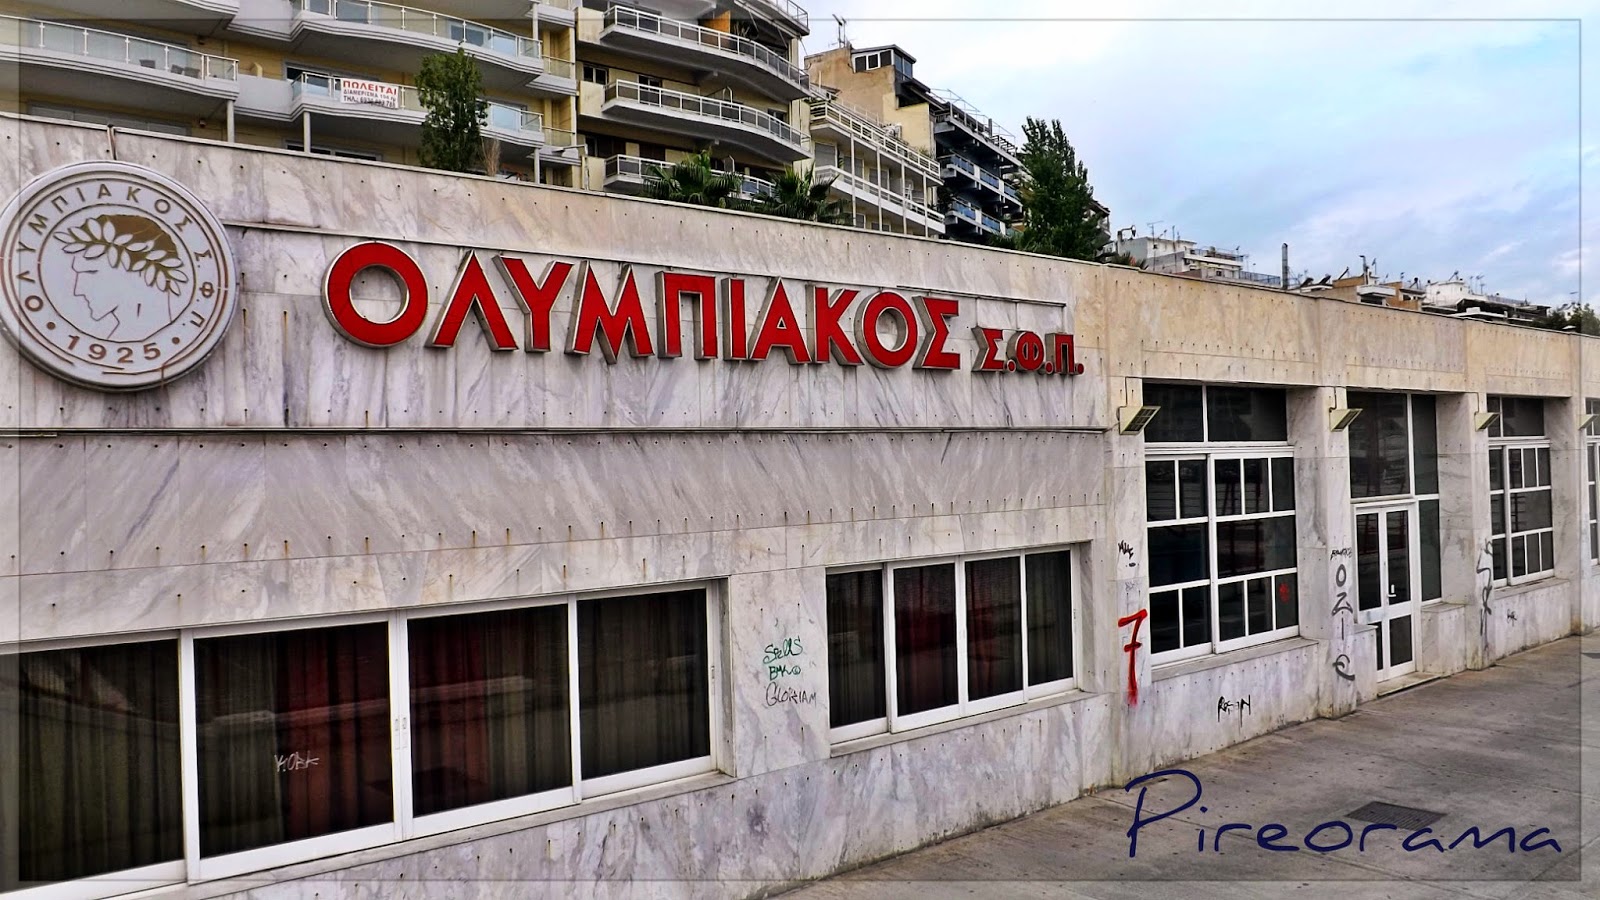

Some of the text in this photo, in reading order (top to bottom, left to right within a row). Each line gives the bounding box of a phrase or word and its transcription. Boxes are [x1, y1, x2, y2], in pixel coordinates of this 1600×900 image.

[343, 80, 397, 95] ΠΩΛΕΙΤΑΙ
[343, 89, 378, 98] ΔΙΑΜΕΡΙΣΜΑ
[16, 183, 193, 312] ΟΛΥΜΠΙΑΚΟΣ
[320, 239, 1084, 376] ΟΛΥΜΠΙΑΚΟΣ Σ.Φ.Π.
[67, 334, 161, 364] 1925
